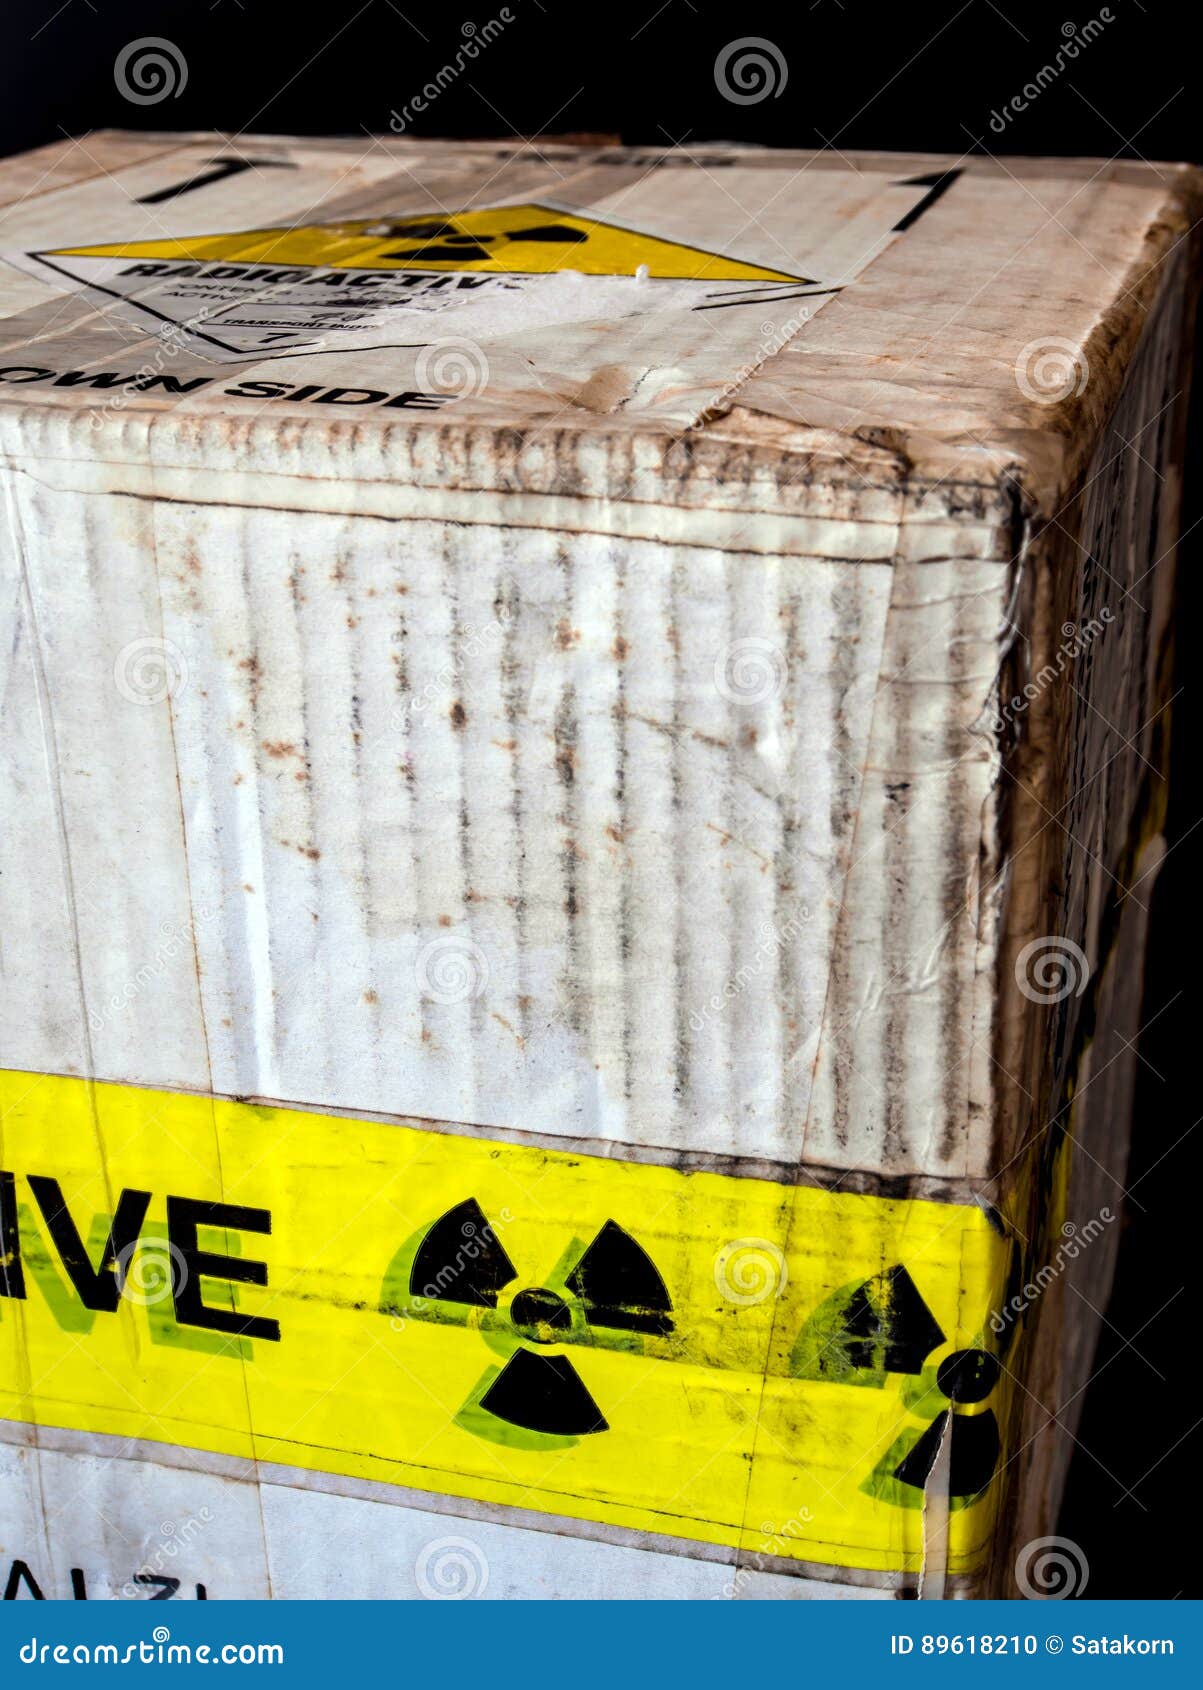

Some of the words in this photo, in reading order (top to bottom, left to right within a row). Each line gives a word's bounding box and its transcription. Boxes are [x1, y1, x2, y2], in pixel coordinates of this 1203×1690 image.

[223, 319, 327, 328] TRANSPORT
[258, 332, 300, 344] 7
[224, 381, 459, 410] SIDE
